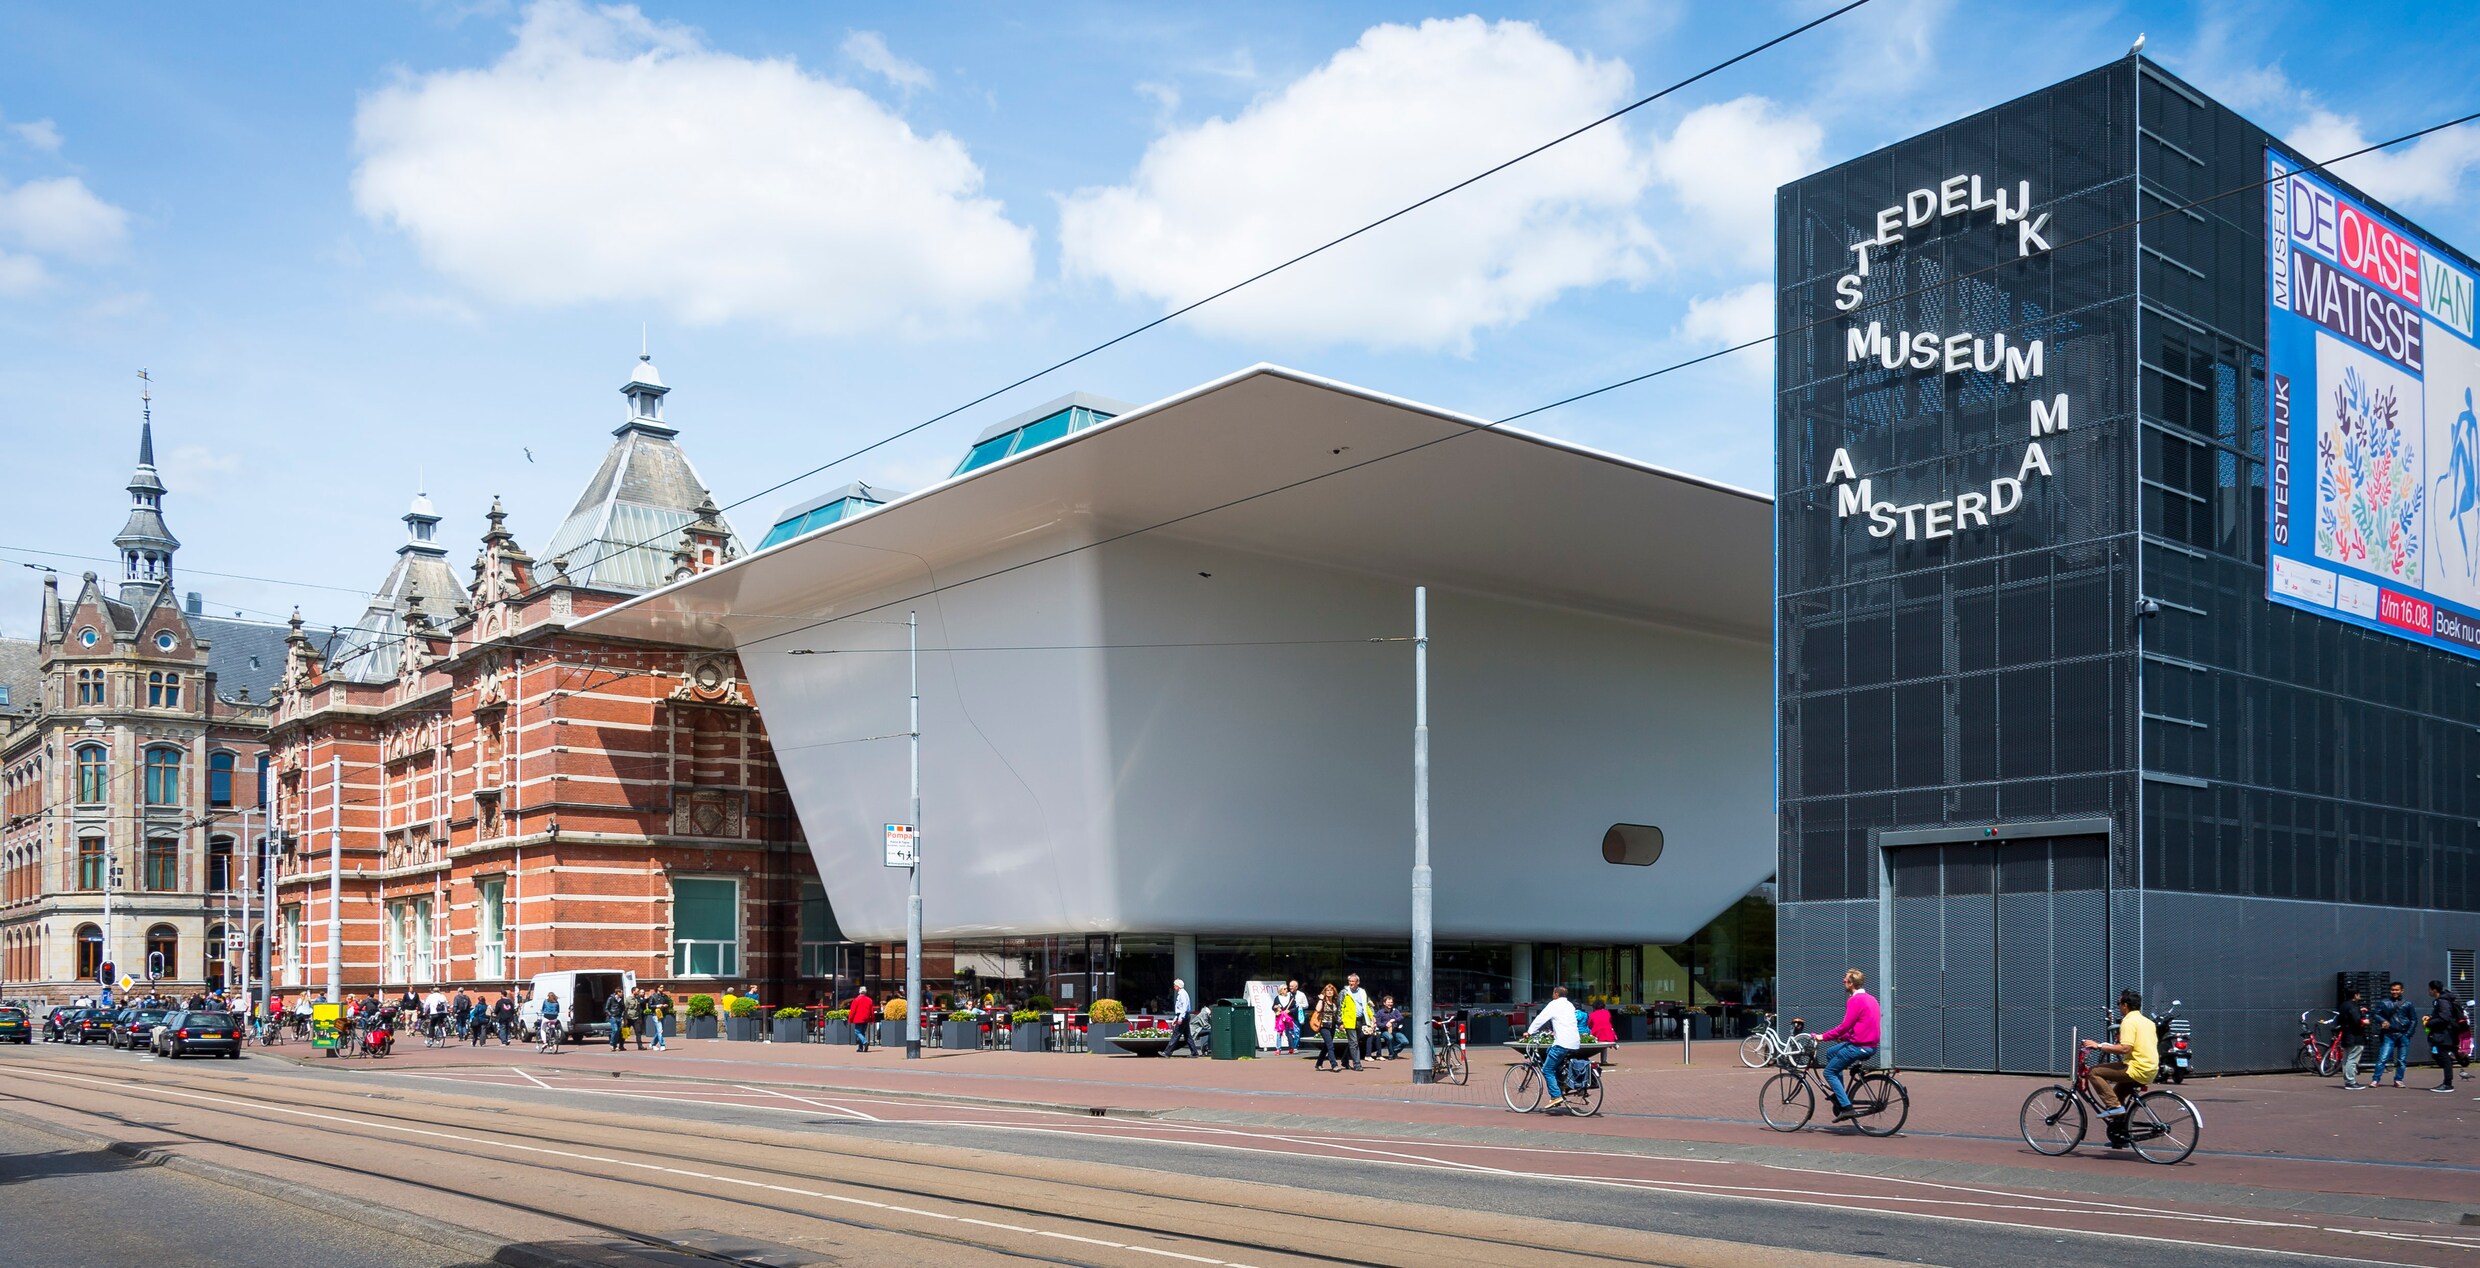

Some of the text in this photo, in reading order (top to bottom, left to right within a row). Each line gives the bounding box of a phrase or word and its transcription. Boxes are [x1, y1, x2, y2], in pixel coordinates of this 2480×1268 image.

[1835, 174, 2050, 311] STEDELIJK
[2293, 178, 2472, 333] DE OASE VAN
[1847, 321, 2043, 383] MUSEUM
[2273, 166, 2289, 544] STEDELIJK MUSEUM
[2293, 251, 2421, 371] MATISSE
[1826, 393, 2069, 541] AMSTERDAM
[2381, 594, 2399, 620] t/m
[2400, 600, 2430, 629] 16.08.
[2436, 610, 2461, 639] Boek
[2462, 624, 2474, 643] nu
[887, 831, 913, 840] Pompa
